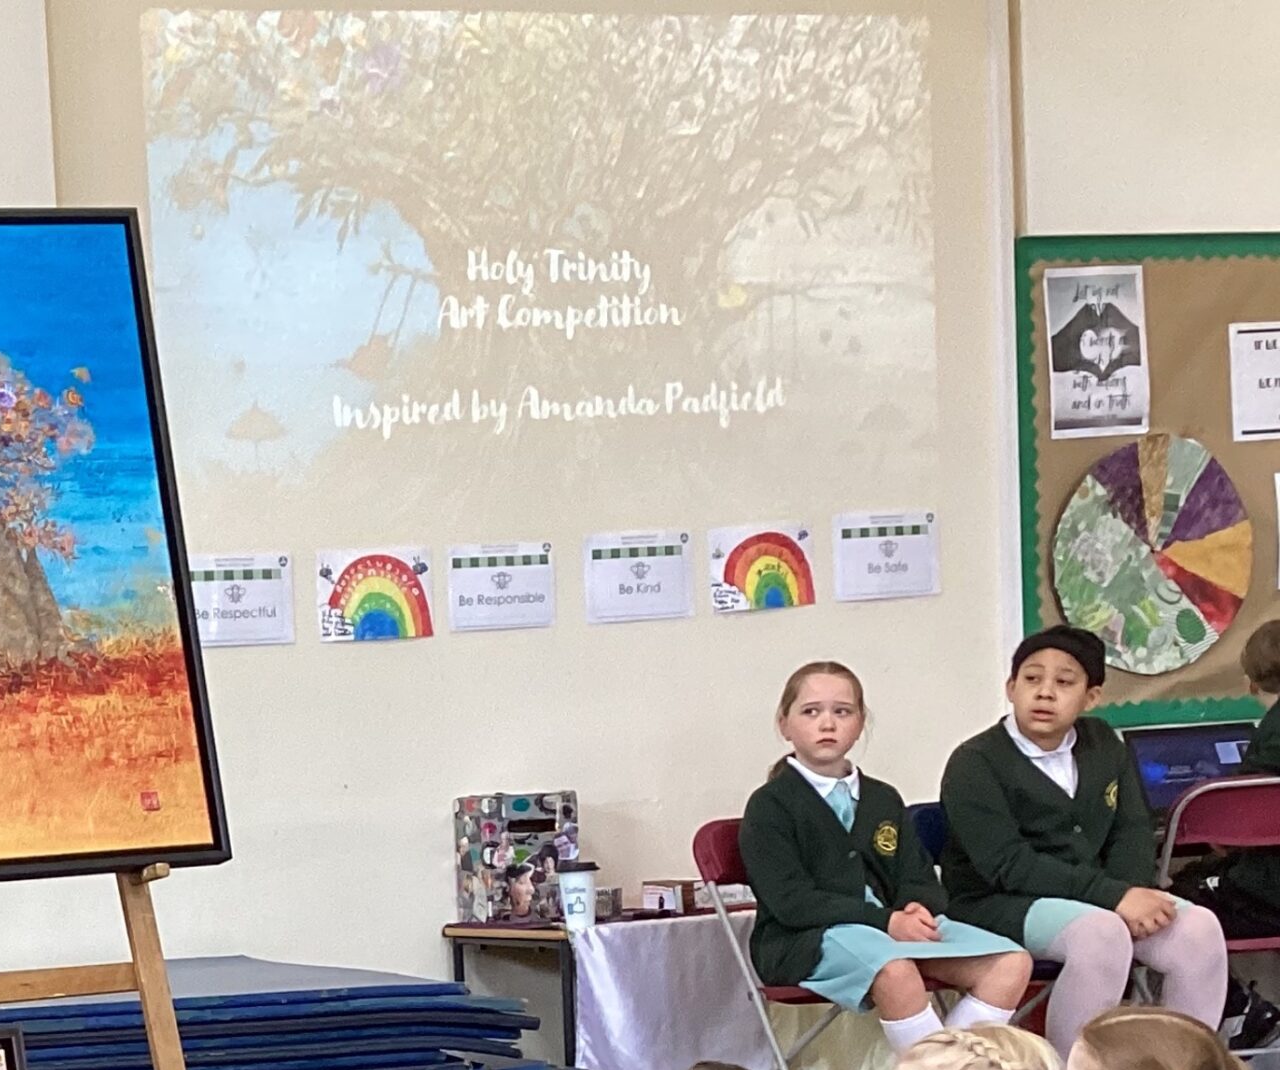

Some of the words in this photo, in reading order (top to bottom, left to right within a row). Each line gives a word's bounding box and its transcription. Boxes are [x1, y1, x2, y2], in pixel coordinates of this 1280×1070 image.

[467, 248, 534, 295] Holy
[544, 248, 651, 295] Trinity
[437, 295, 490, 330] Art
[496, 293, 682, 340] Competition
[333, 388, 462, 440] Inspired
[472, 388, 507, 435] by
[517, 384, 660, 422] Amanda
[663, 376, 787, 428] Padfield
[867, 563, 882, 574] Be
[884, 561, 909, 573] Safe
[619, 583, 634, 595] Be
[636, 582, 662, 593] Kind
[458, 594, 474, 607] Be
[477, 592, 546, 607] Responsible
[213, 606, 277, 621] Respectful
